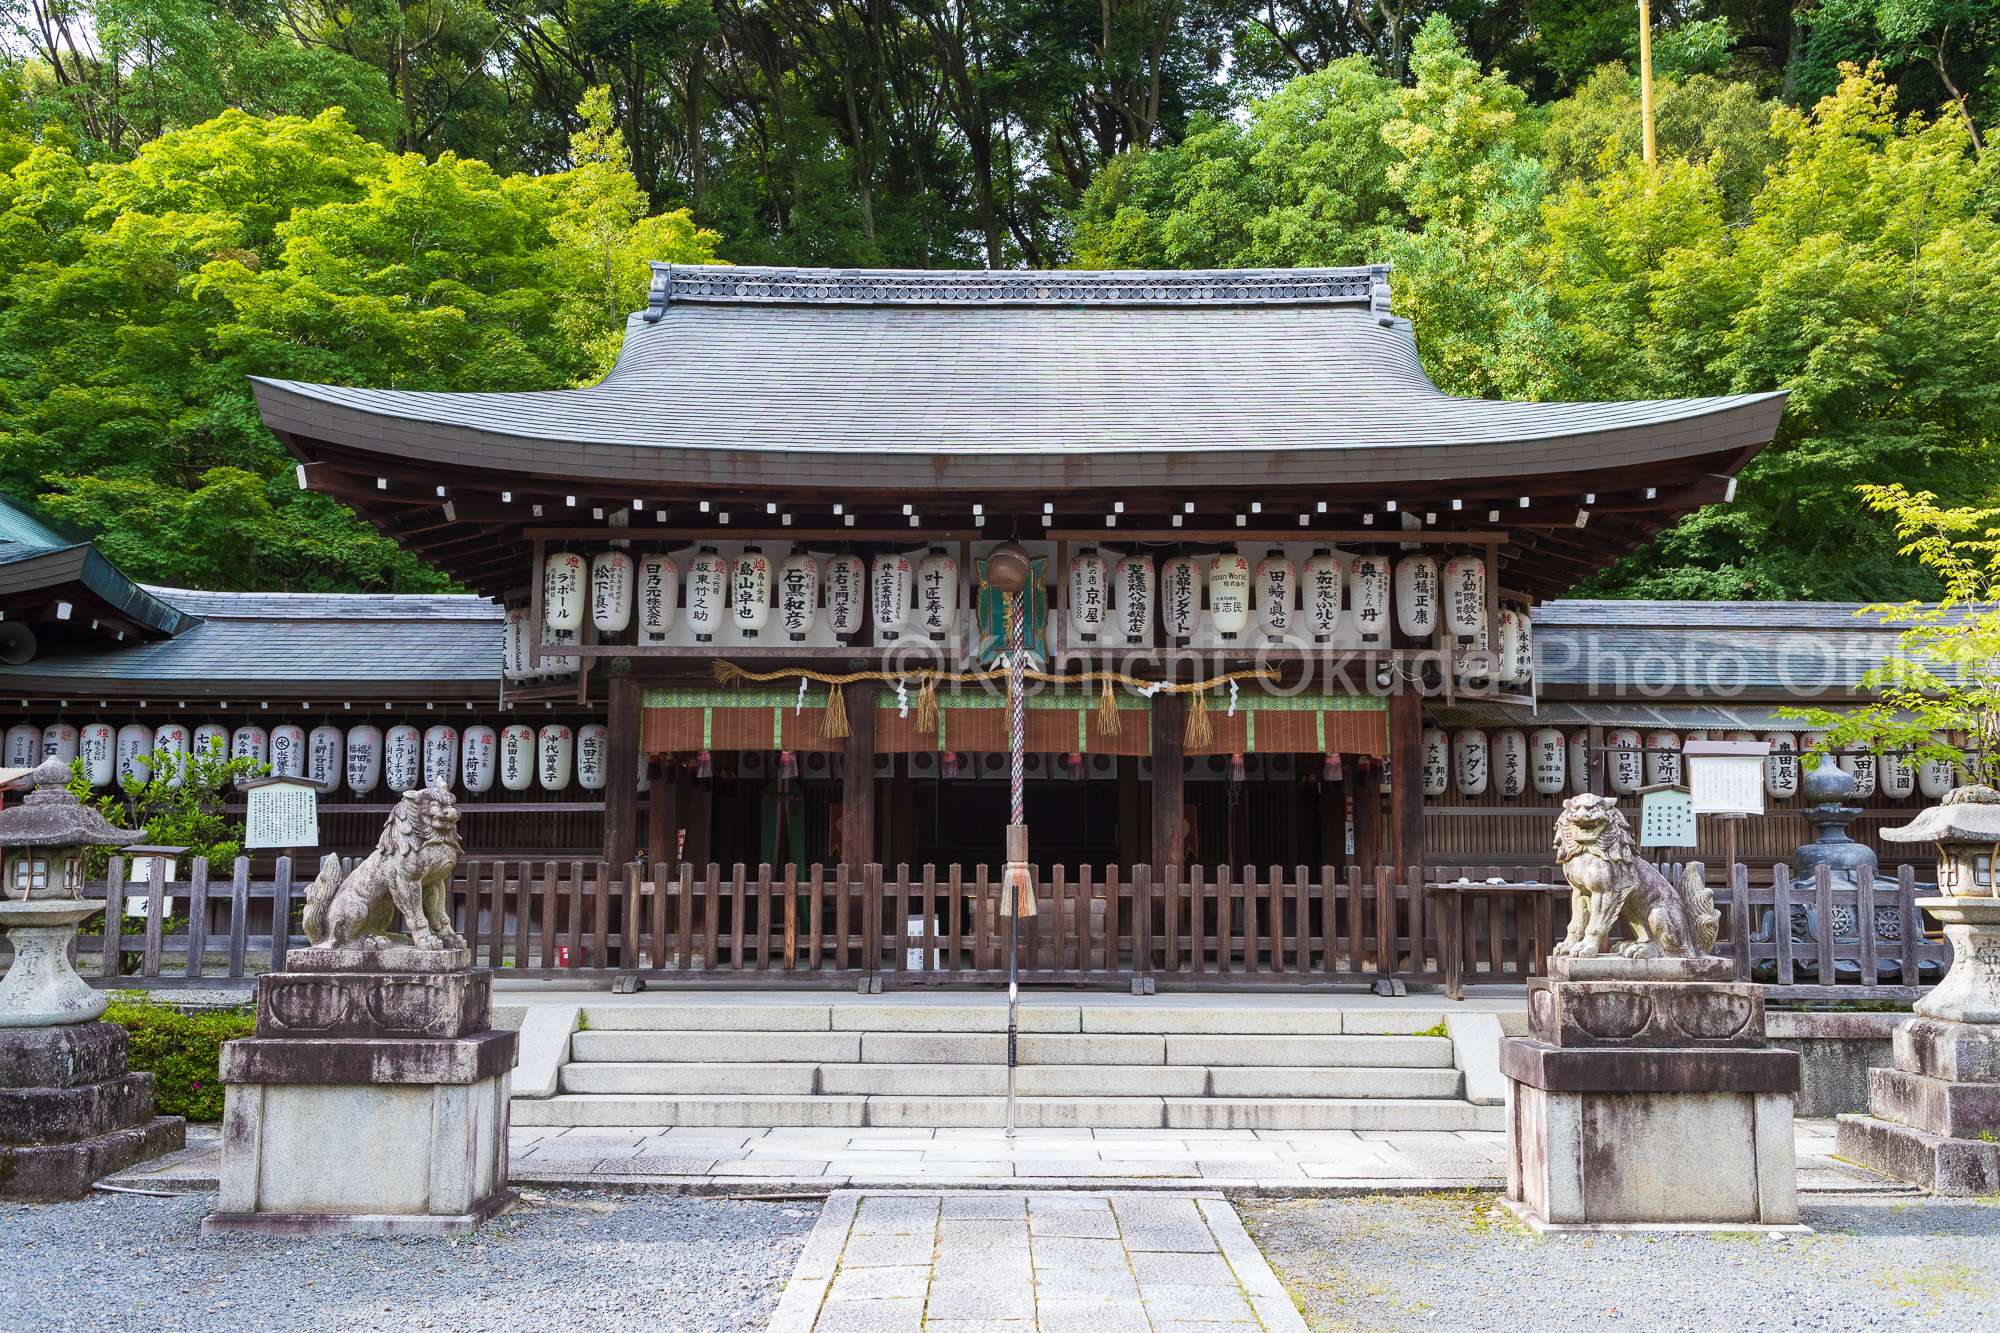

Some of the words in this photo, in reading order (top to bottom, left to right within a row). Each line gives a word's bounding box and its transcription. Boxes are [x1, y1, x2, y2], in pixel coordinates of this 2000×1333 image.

[557, 573, 570, 619] ラポール
[594, 565, 610, 620] 松下真二
[693, 562, 712, 622] 坂東竹之助
[784, 568, 806, 628] 石黒和彦
[880, 563, 894, 624] 井上工業有限会社
[1175, 564, 1192, 633] 京都ホンダオート
[1210, 574, 1228, 582] Japan
[1228, 572, 1246, 580] World
[1224, 580, 1246, 588] 株式会社
[1462, 569, 1478, 626] 不動院教会
[506, 734, 518, 780] 久保田喜美子
[1465, 744, 1482, 786] アダン
[1504, 754, 1518, 794] マキノ病院
